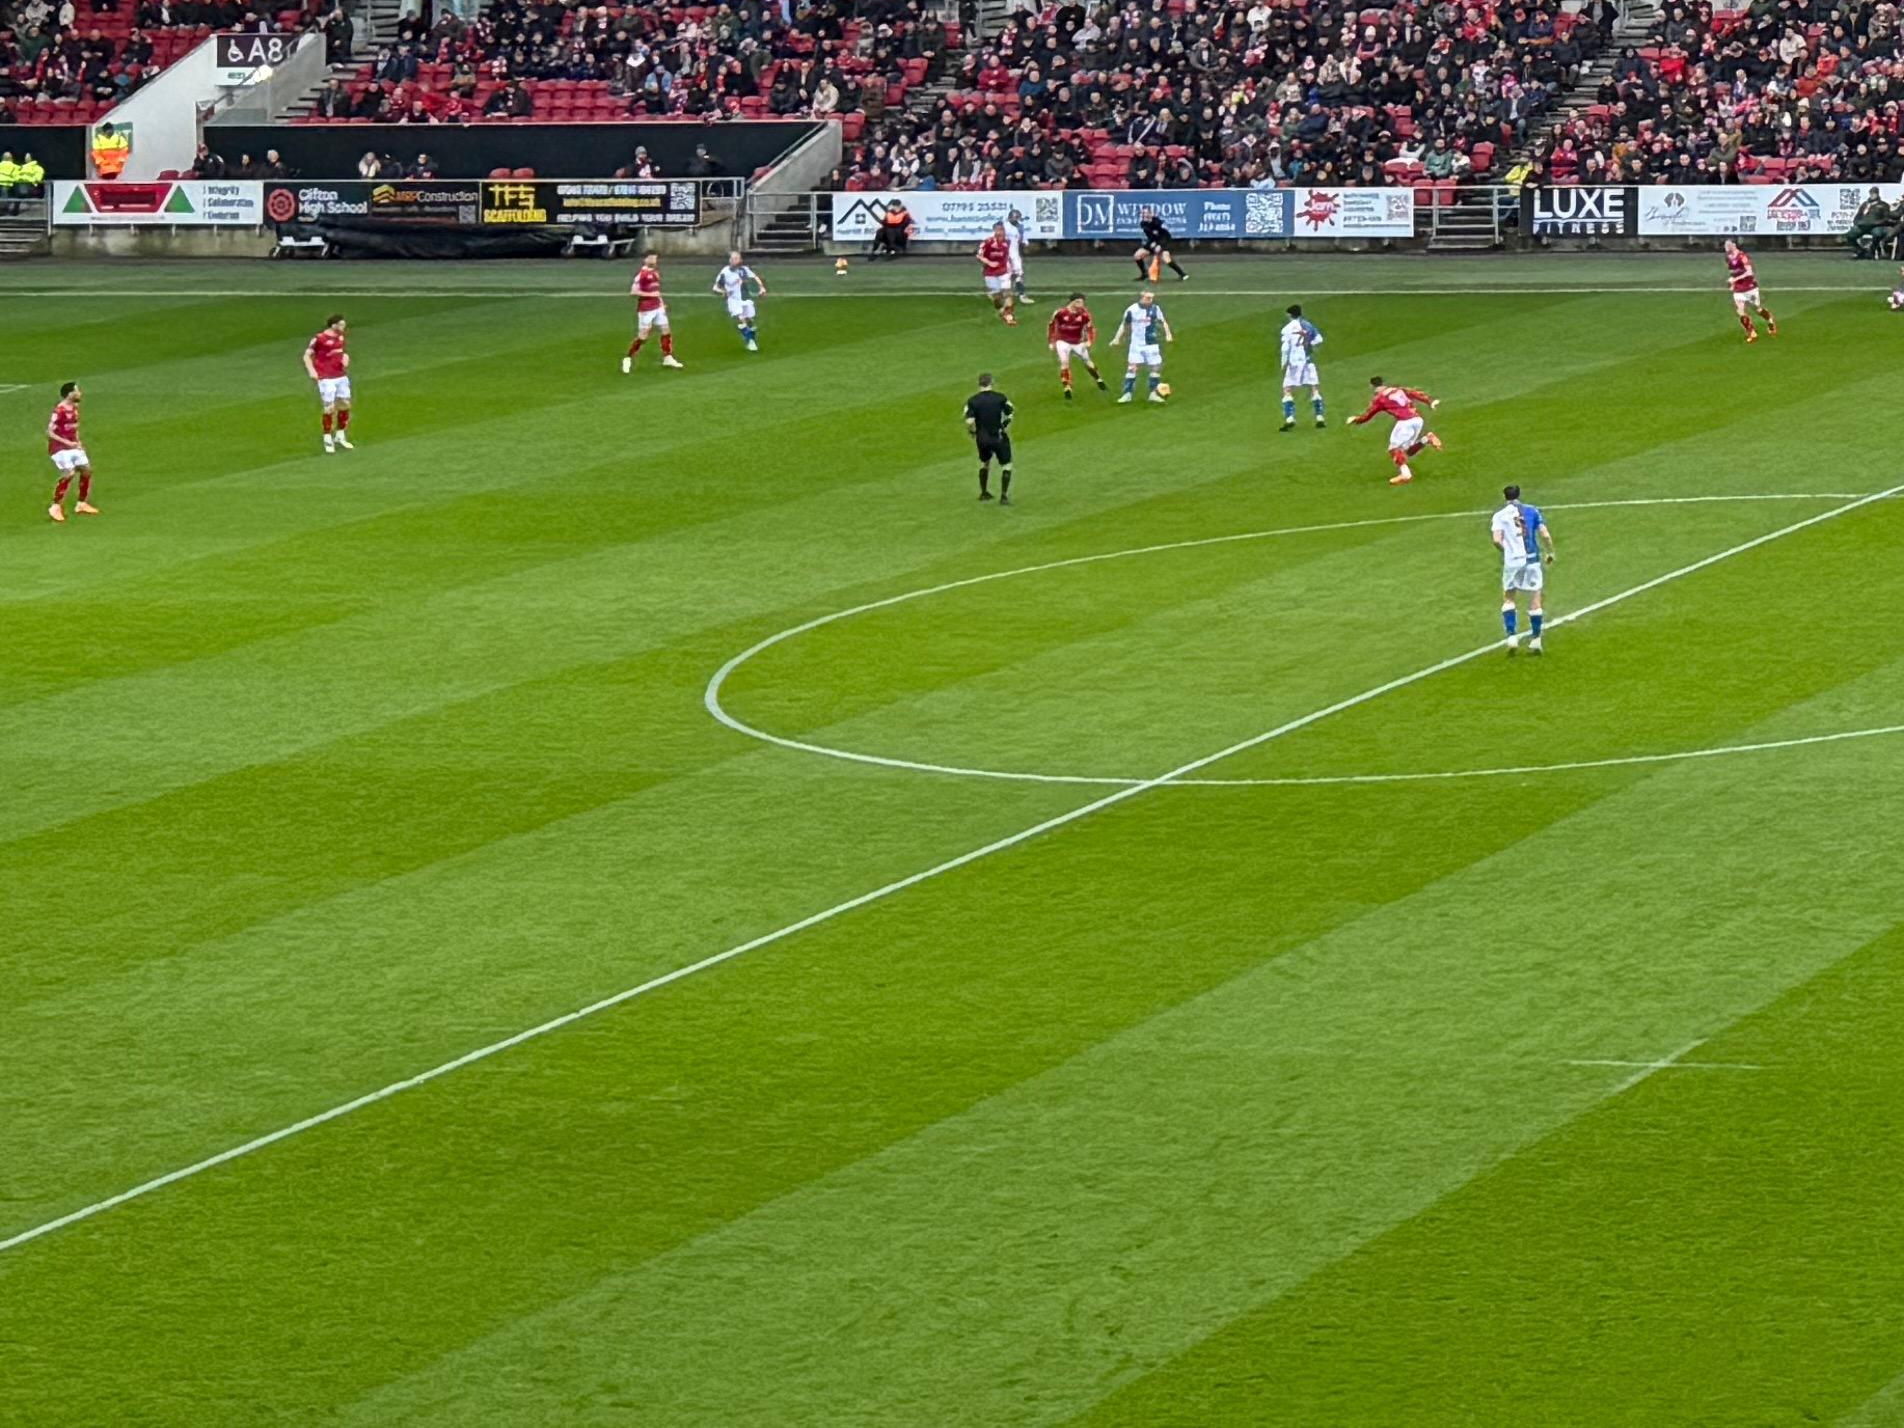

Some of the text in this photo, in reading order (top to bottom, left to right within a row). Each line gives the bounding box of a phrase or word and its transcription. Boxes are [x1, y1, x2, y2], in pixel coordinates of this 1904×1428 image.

[248, 36, 284, 63] A8
[298, 187, 339, 202] Clifton
[488, 184, 536, 210] TFS
[298, 201, 326, 215] High
[328, 201, 368, 215] School
[1534, 188, 1626, 219] LUXE
[484, 209, 547, 223] SCAFFOLDING
[1532, 221, 1625, 235] FITNESS
